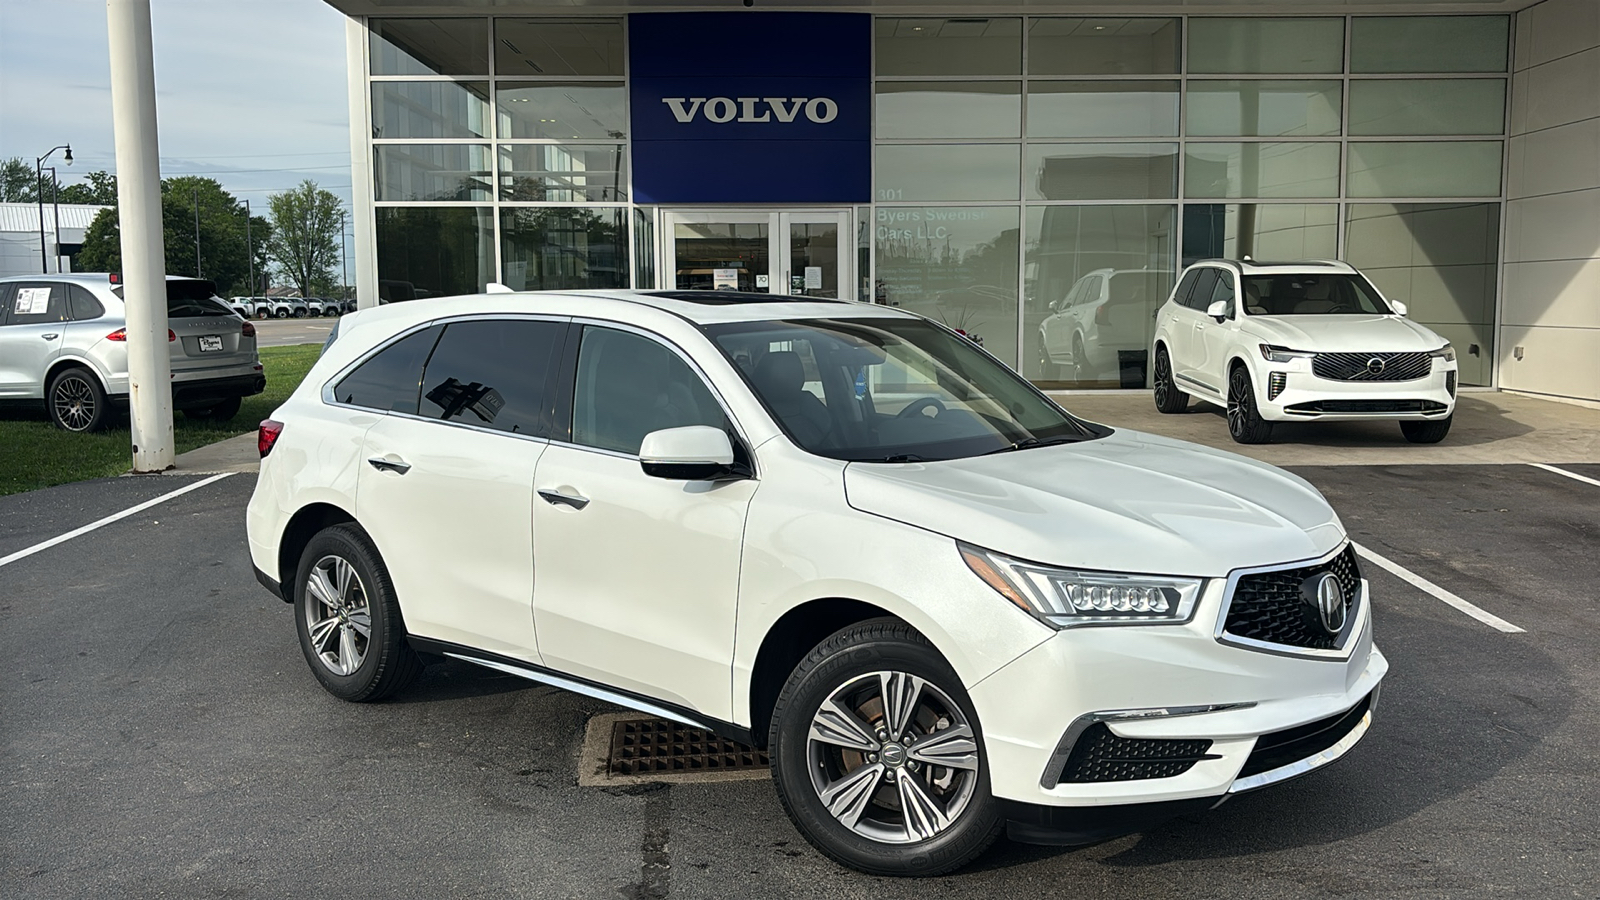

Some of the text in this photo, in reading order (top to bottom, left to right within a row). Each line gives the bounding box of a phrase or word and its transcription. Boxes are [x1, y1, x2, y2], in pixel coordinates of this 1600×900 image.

[662, 97, 838, 123] VOLVO
[878, 188, 902, 200] 301
[877, 208, 920, 224] Byers
[877, 226, 947, 240] Cars LLC
